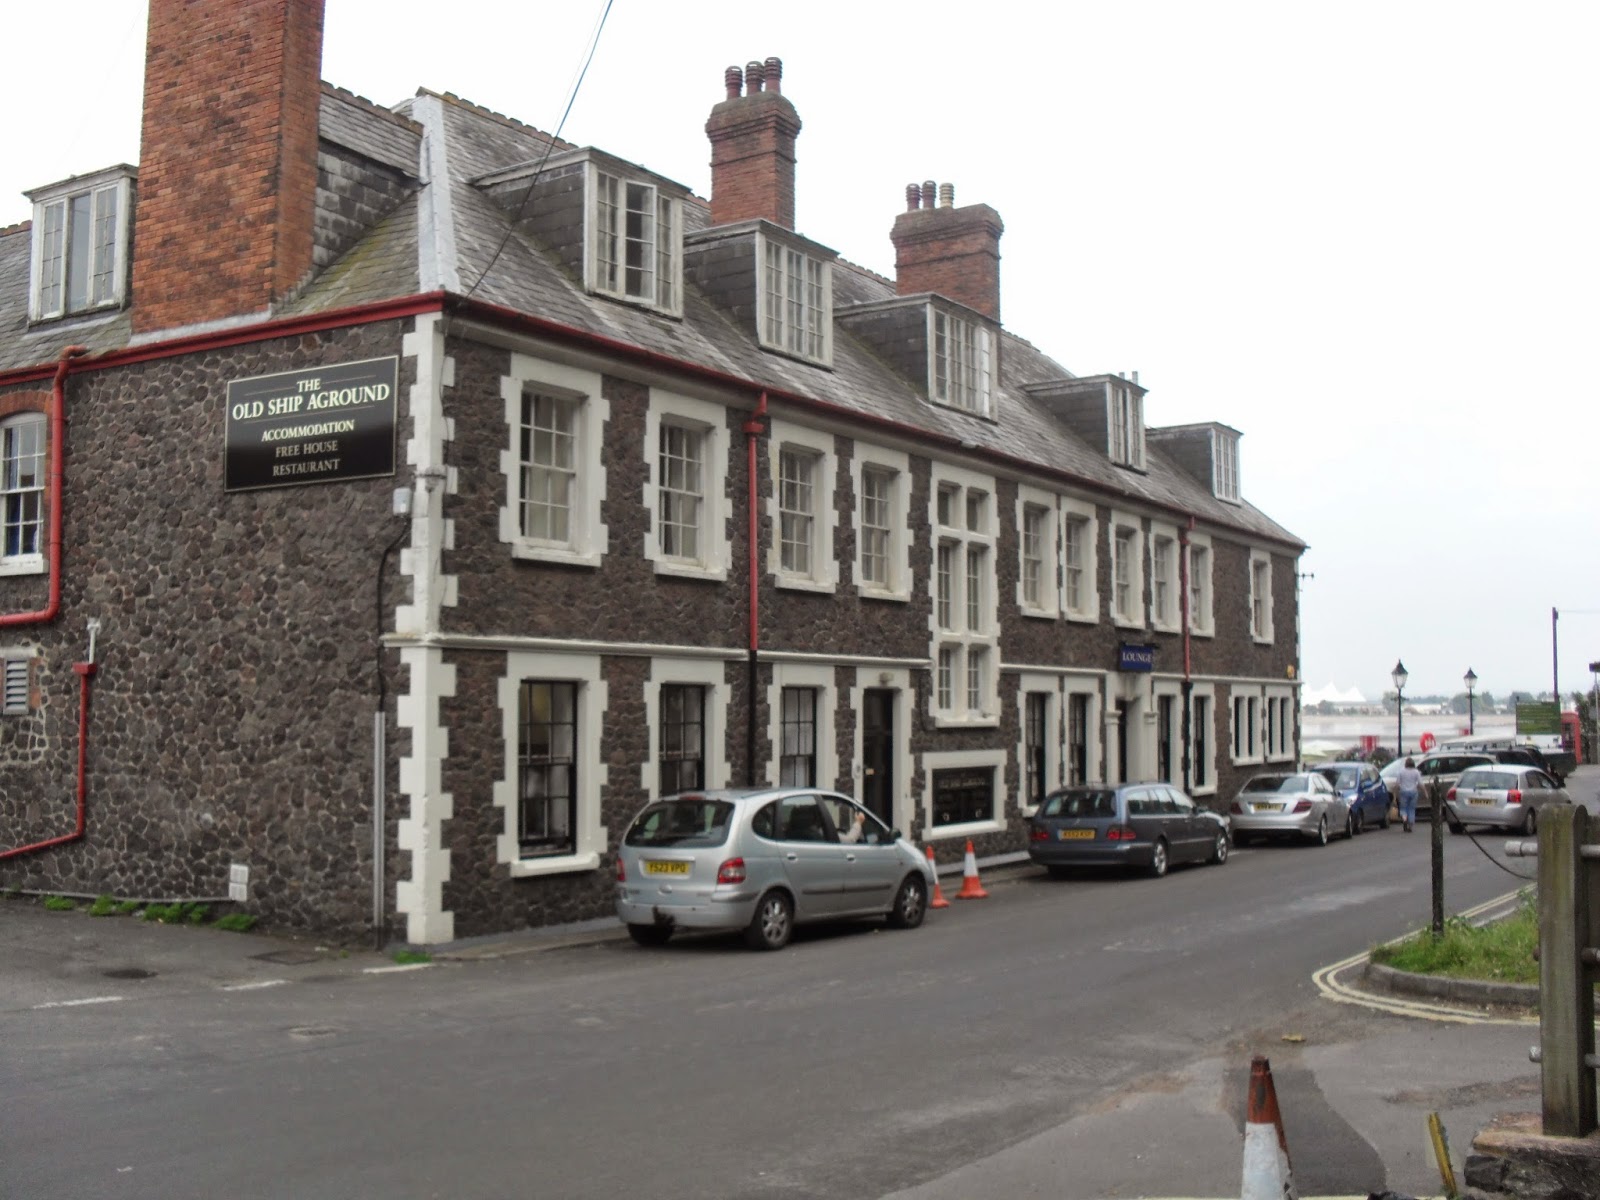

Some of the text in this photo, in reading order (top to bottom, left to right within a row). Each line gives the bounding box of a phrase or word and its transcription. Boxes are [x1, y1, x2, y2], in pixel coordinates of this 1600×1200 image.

[297, 378, 321, 393] THE
[232, 383, 390, 421] OLD SHIP AGROUND
[261, 419, 355, 442] ACCOMMODATION
[275, 440, 338, 458] FREE HOUSE
[272, 459, 341, 477] RESTAURANT
[1122, 652, 1151, 663] LOUNGE
